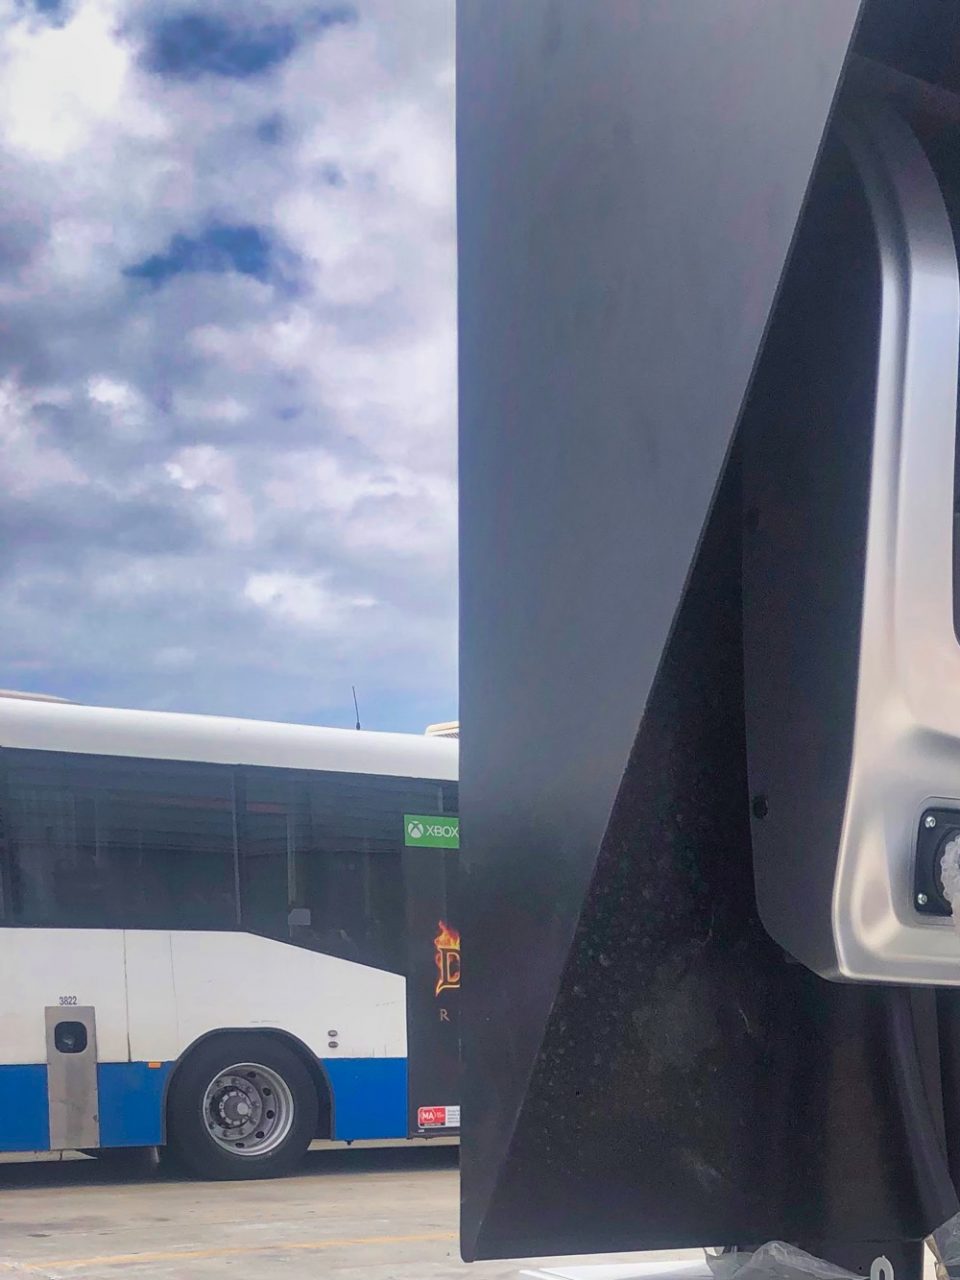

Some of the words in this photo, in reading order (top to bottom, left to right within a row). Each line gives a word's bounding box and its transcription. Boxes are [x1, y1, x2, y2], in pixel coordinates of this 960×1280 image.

[426, 825, 460, 838] XBOX
[59, 995, 78, 1006] 3822
[422, 1112, 434, 1120] MA
